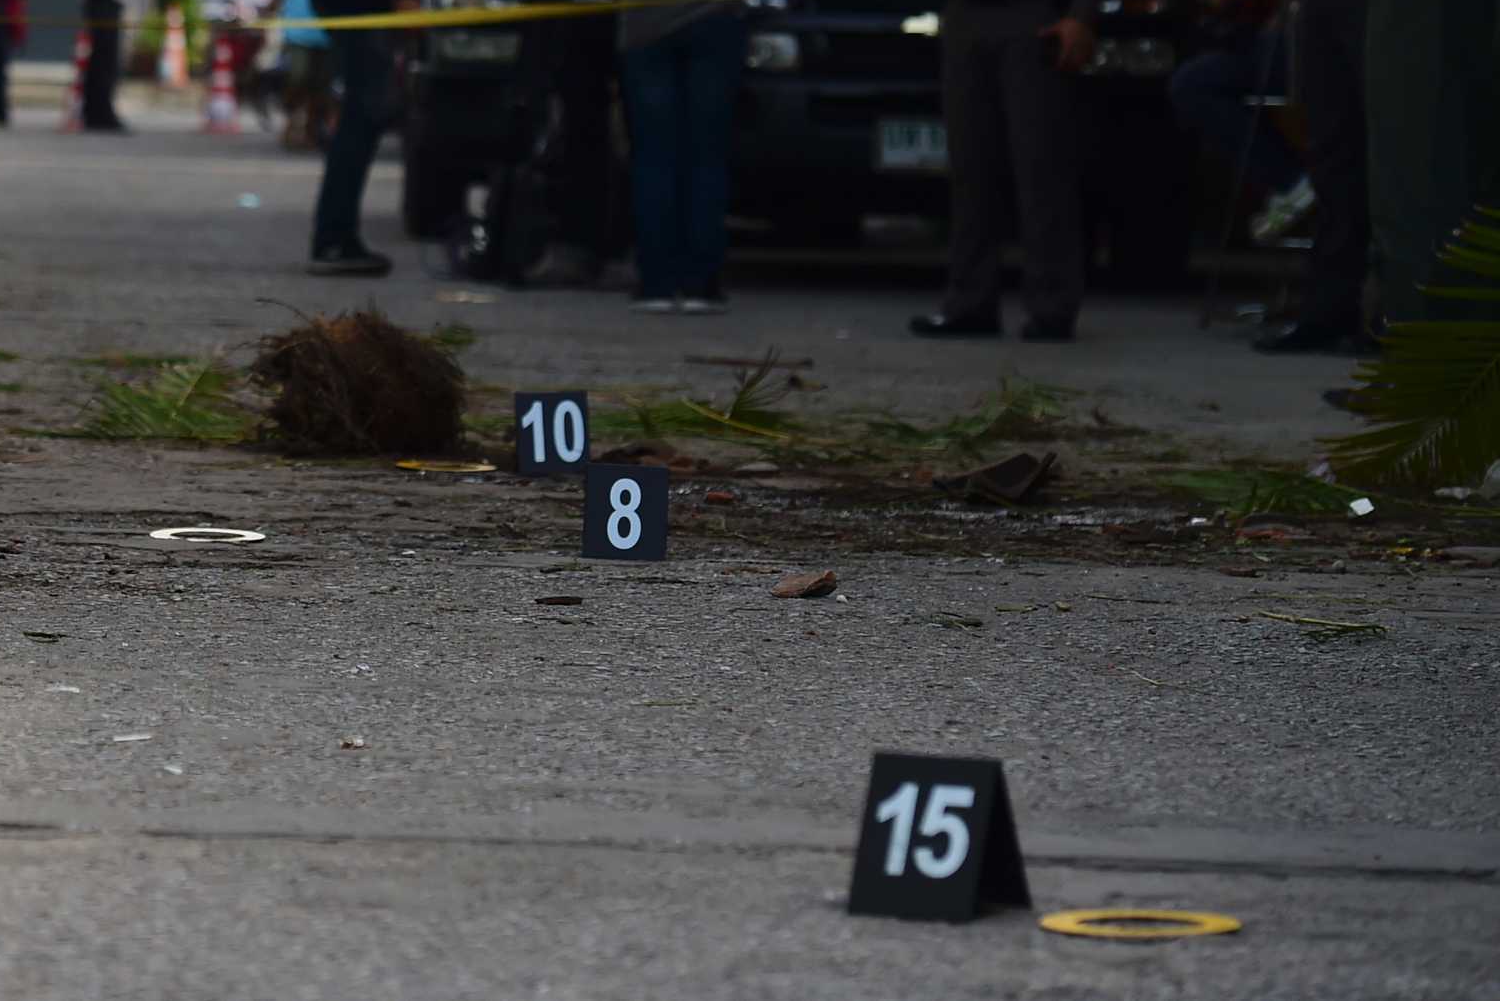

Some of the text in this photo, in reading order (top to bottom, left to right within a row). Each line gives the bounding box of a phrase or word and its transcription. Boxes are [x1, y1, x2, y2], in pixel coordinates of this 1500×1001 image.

[521, 399, 585, 463] 10
[606, 477, 642, 550] 8
[874, 780, 976, 880] 15
